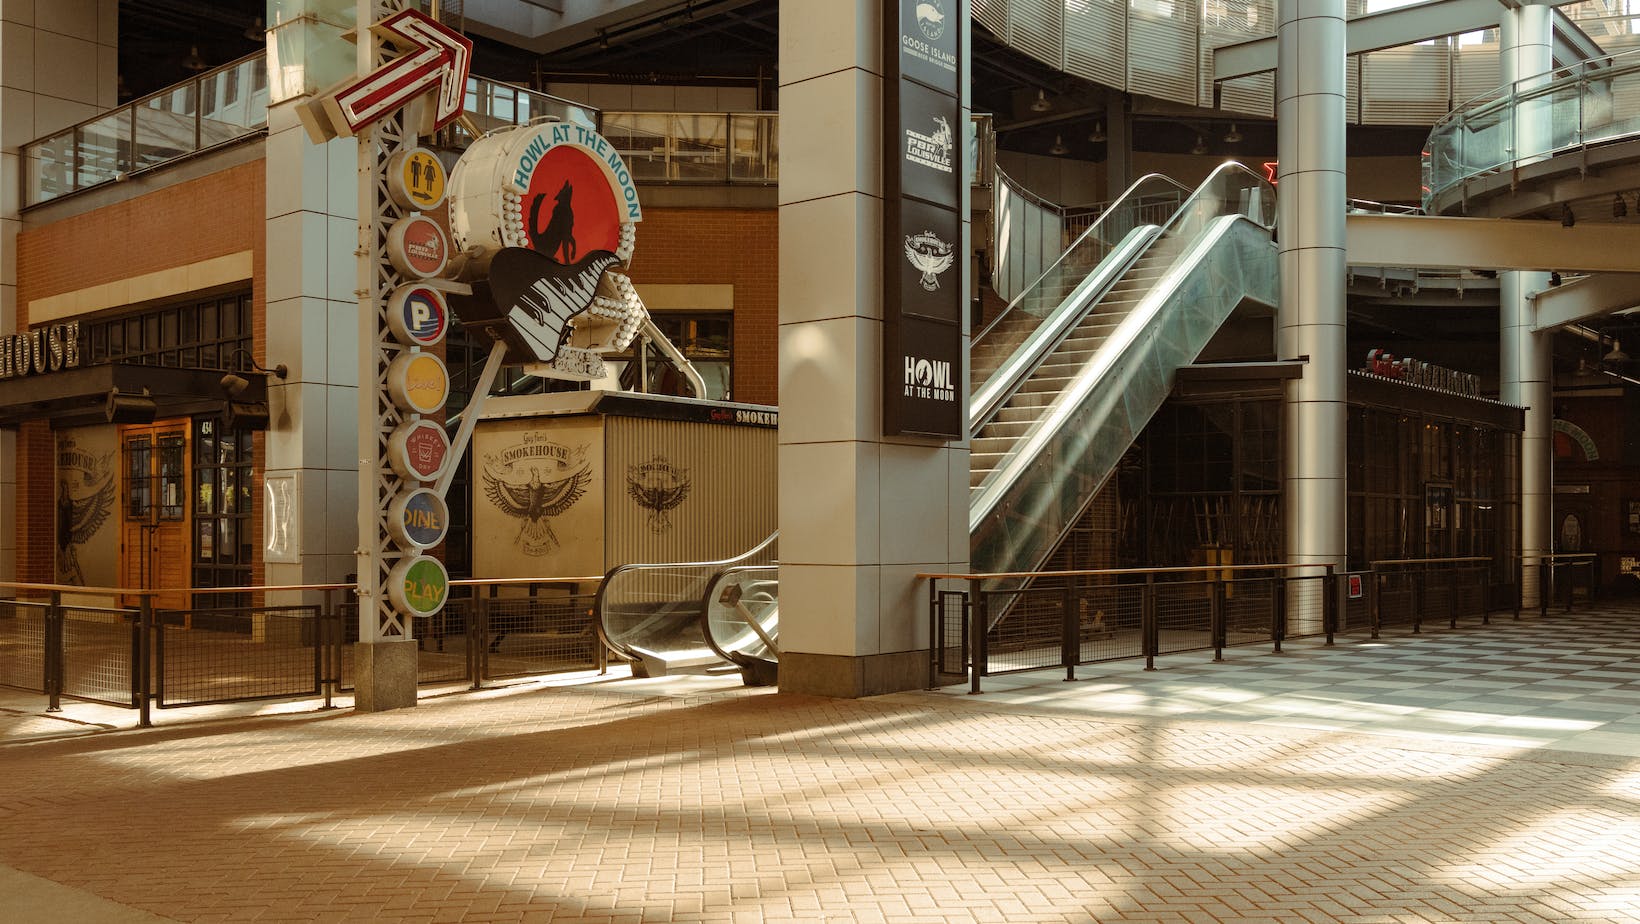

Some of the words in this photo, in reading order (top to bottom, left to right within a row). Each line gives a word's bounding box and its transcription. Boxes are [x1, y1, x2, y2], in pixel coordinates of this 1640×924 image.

[902, 34, 929, 54] GOOSE
[931, 46, 957, 65] ISLAND
[907, 137, 936, 153] PBR
[907, 144, 951, 166] LOUISVILLE
[514, 134, 551, 190] HOWL
[552, 124, 570, 144] AT
[575, 126, 607, 158] THE
[607, 152, 640, 218] MOON
[411, 301, 430, 331] P
[0, 320, 79, 378] HOUSE
[904, 356, 954, 390] HOWL
[904, 385, 914, 397] AT
[916, 386, 931, 399] THE
[933, 389, 955, 402] MOON
[202, 421, 213, 434] 434
[504, 445, 569, 463] SMOKEHOUSE
[404, 508, 441, 530] DINE
[404, 580, 444, 602] PLAY
